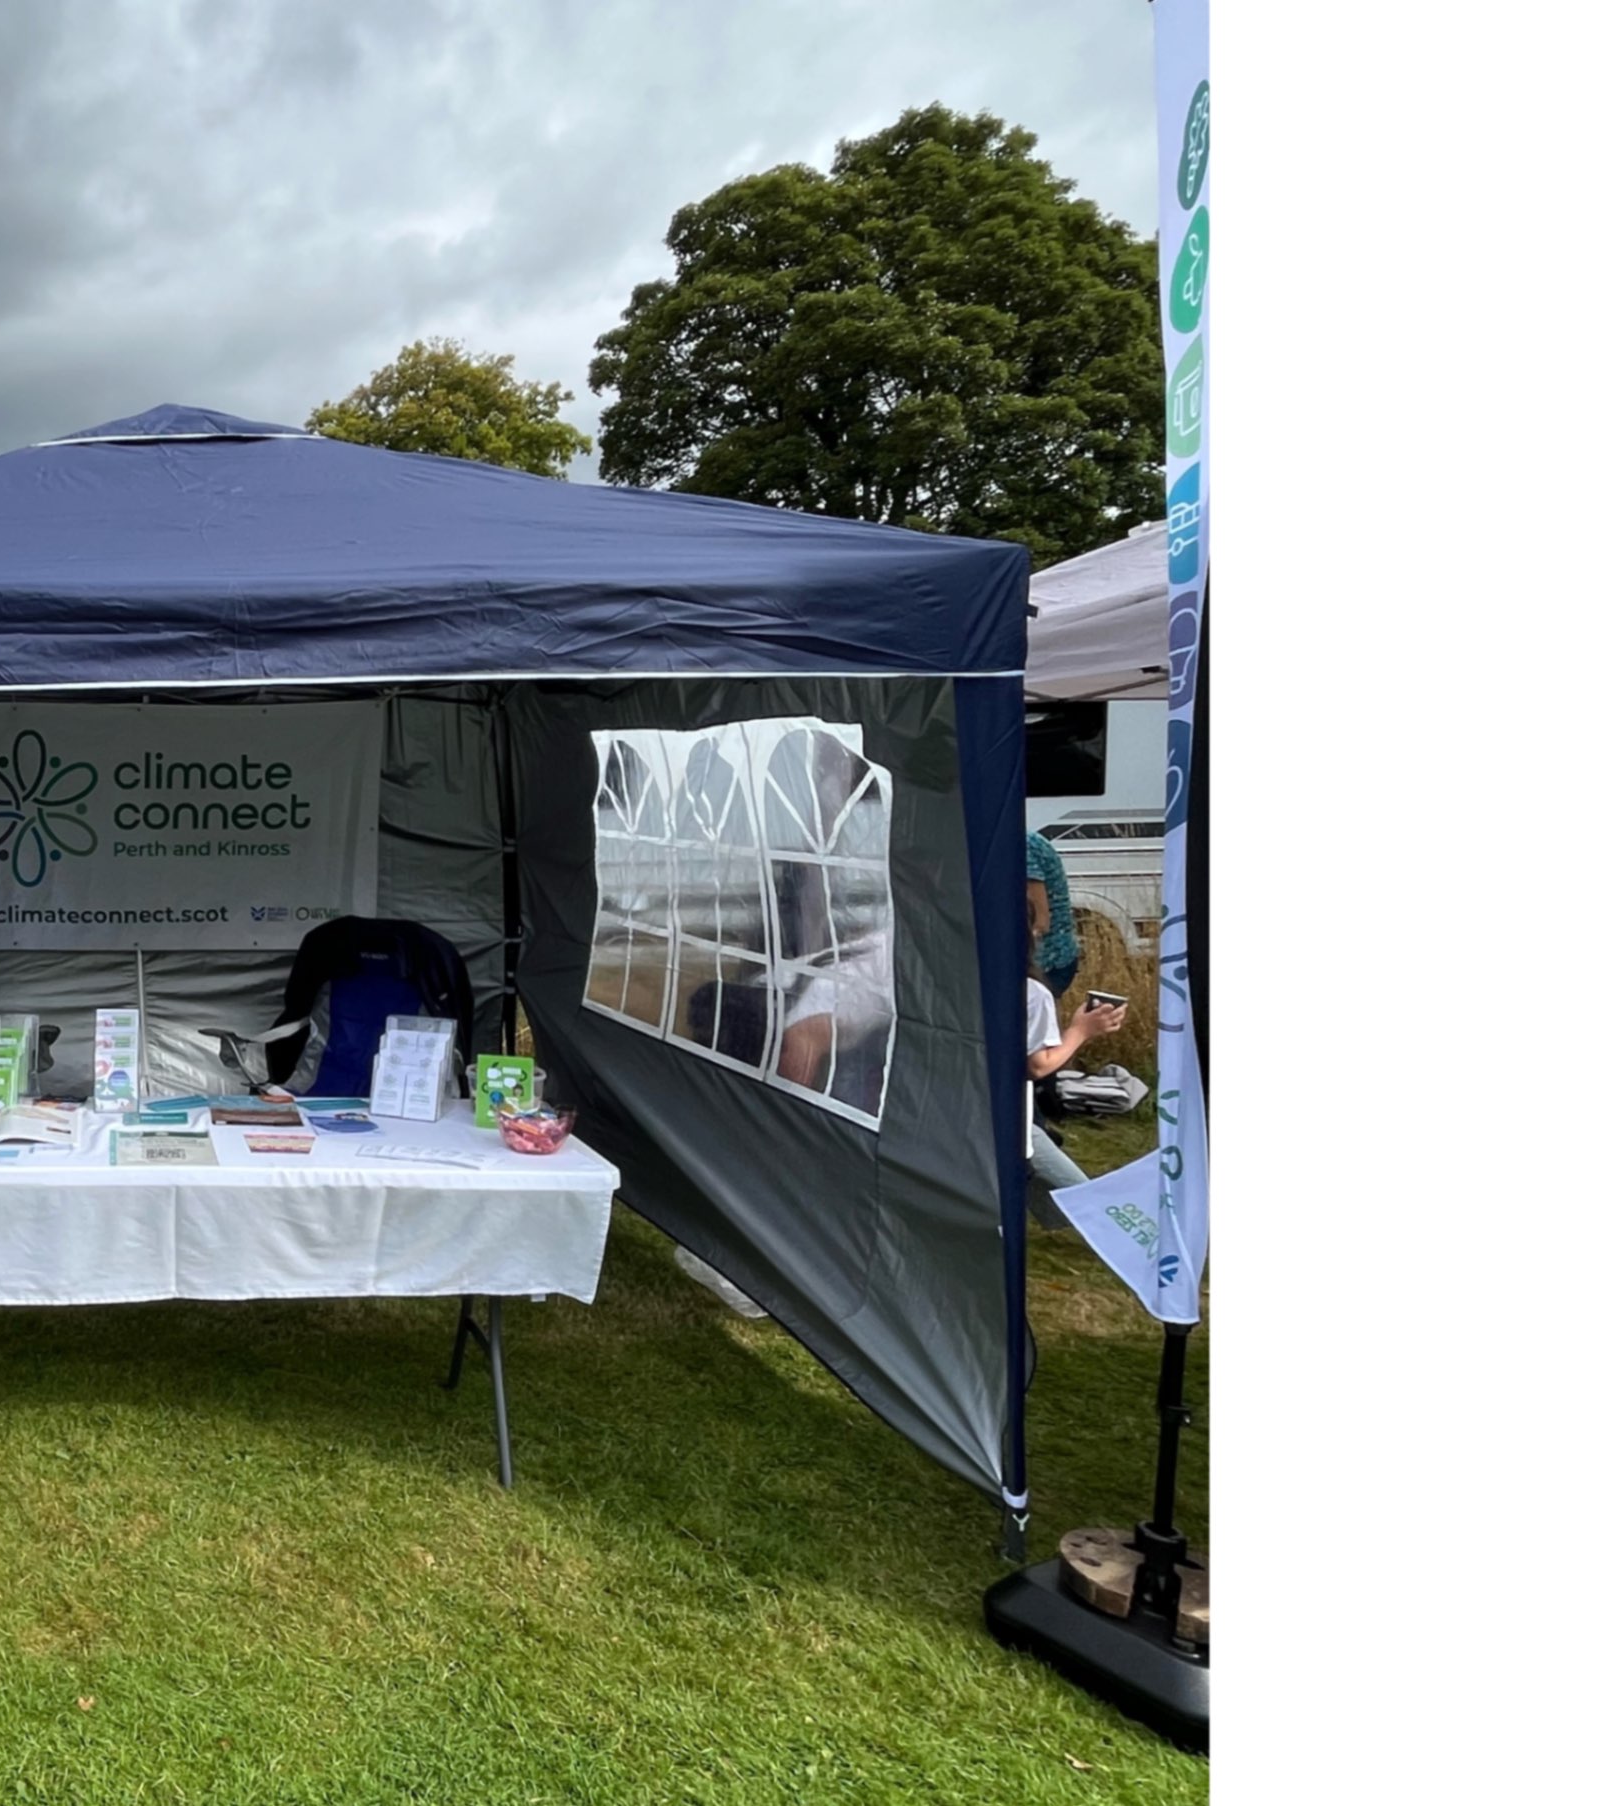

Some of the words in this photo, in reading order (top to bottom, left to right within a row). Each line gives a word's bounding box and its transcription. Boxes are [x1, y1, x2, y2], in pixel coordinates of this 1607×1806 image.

[114, 752, 292, 790] climate
[114, 794, 311, 830] connect
[113, 841, 167, 857] Perth
[173, 841, 211, 857] and
[217, 841, 291, 857] Kinross
